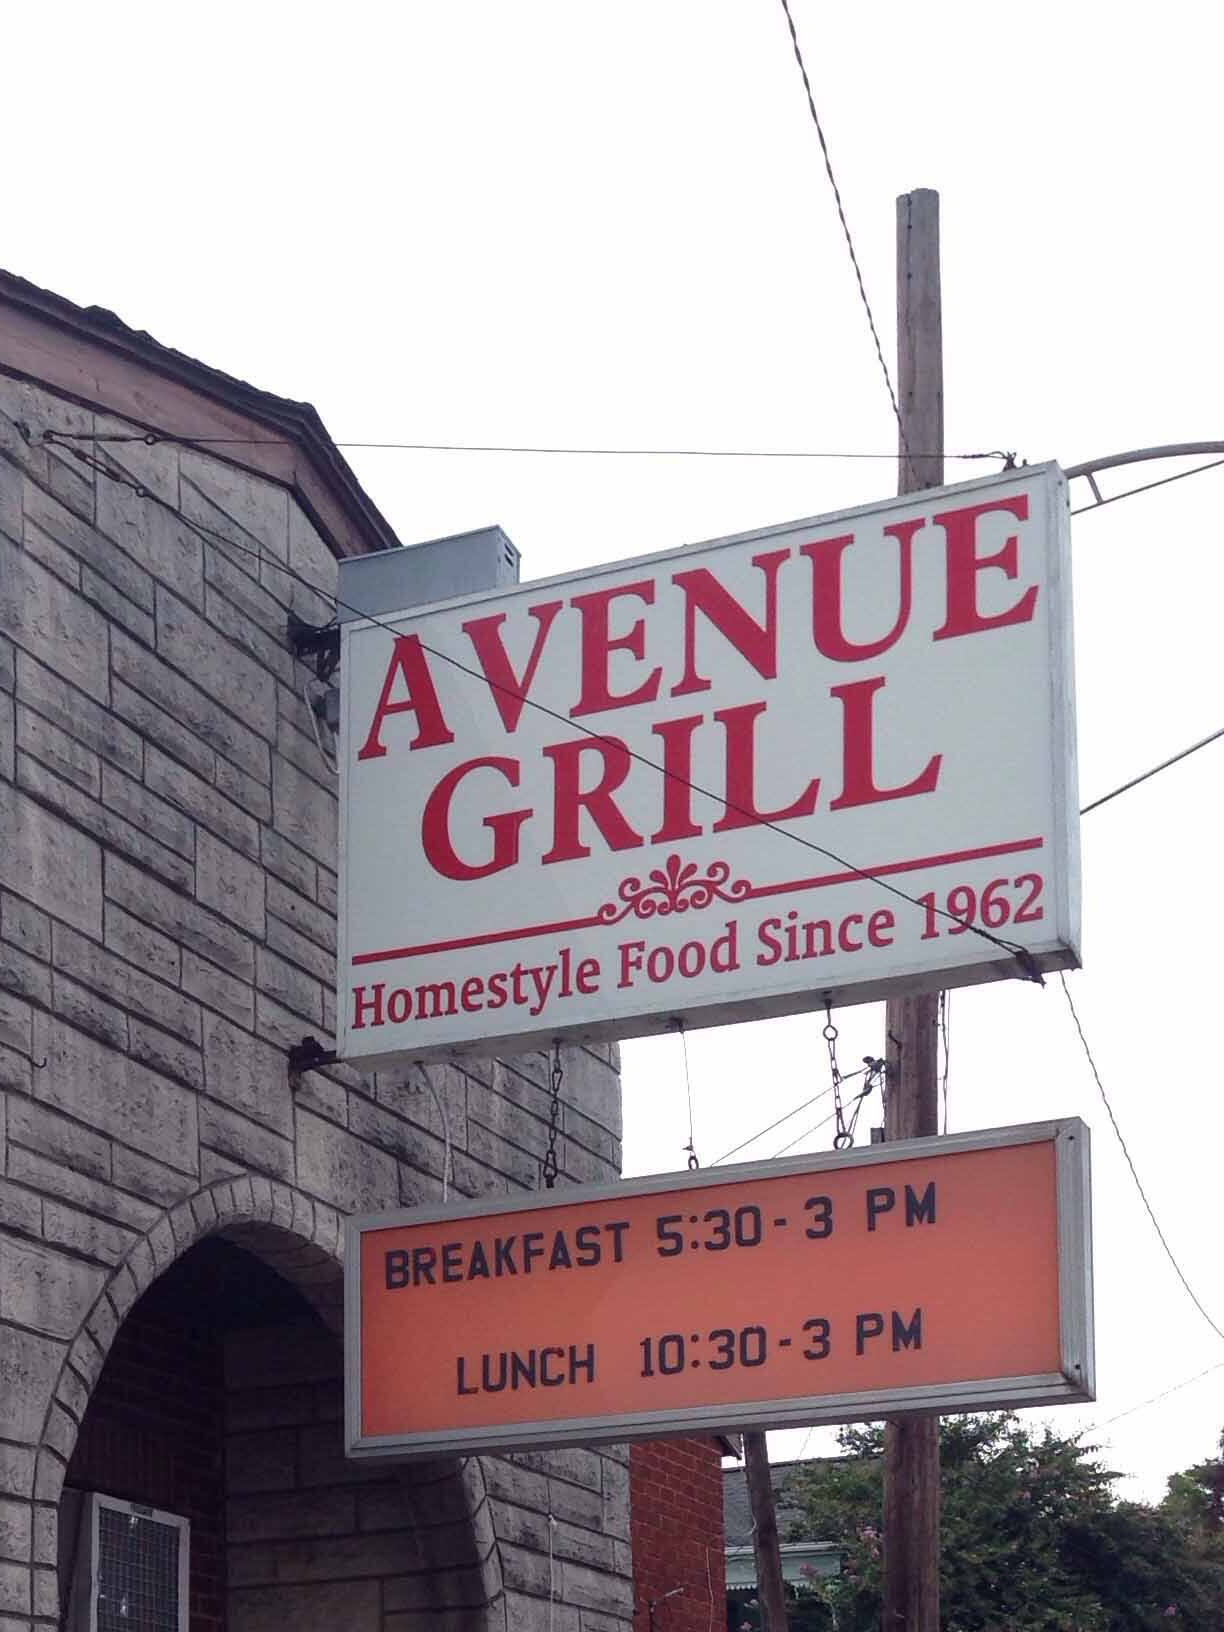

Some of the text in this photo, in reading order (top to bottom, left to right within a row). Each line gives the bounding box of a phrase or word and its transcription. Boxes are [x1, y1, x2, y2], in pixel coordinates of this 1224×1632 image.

[357, 494, 1040, 761] AVENUE
[421, 676, 943, 881] GRILL
[351, 873, 1044, 1030] Homestyle Food Since 1962
[384, 1219, 631, 1290] BREAKFAST
[866, 1180, 937, 1233] PM
[456, 1343, 596, 1397] LUNCH
[855, 1307, 923, 1356] PM
